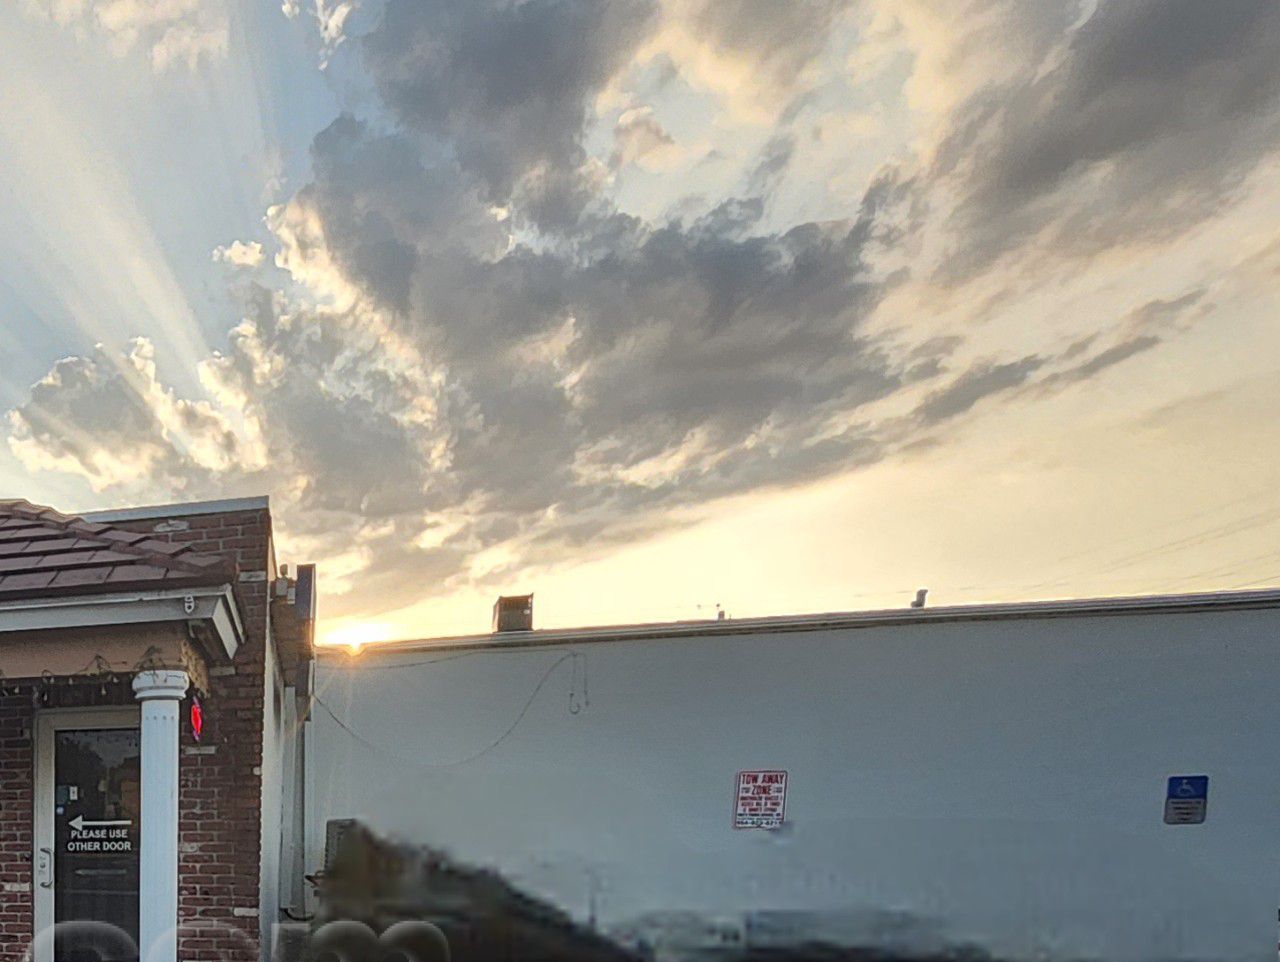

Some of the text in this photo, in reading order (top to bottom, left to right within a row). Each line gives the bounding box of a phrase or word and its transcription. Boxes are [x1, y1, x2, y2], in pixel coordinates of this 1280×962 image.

[742, 774, 784, 785] TOW AWAY
[752, 785, 771, 795] ZONE
[70, 829, 128, 839] PLEASE USE
[67, 841, 131, 851] OTHER DOOR
